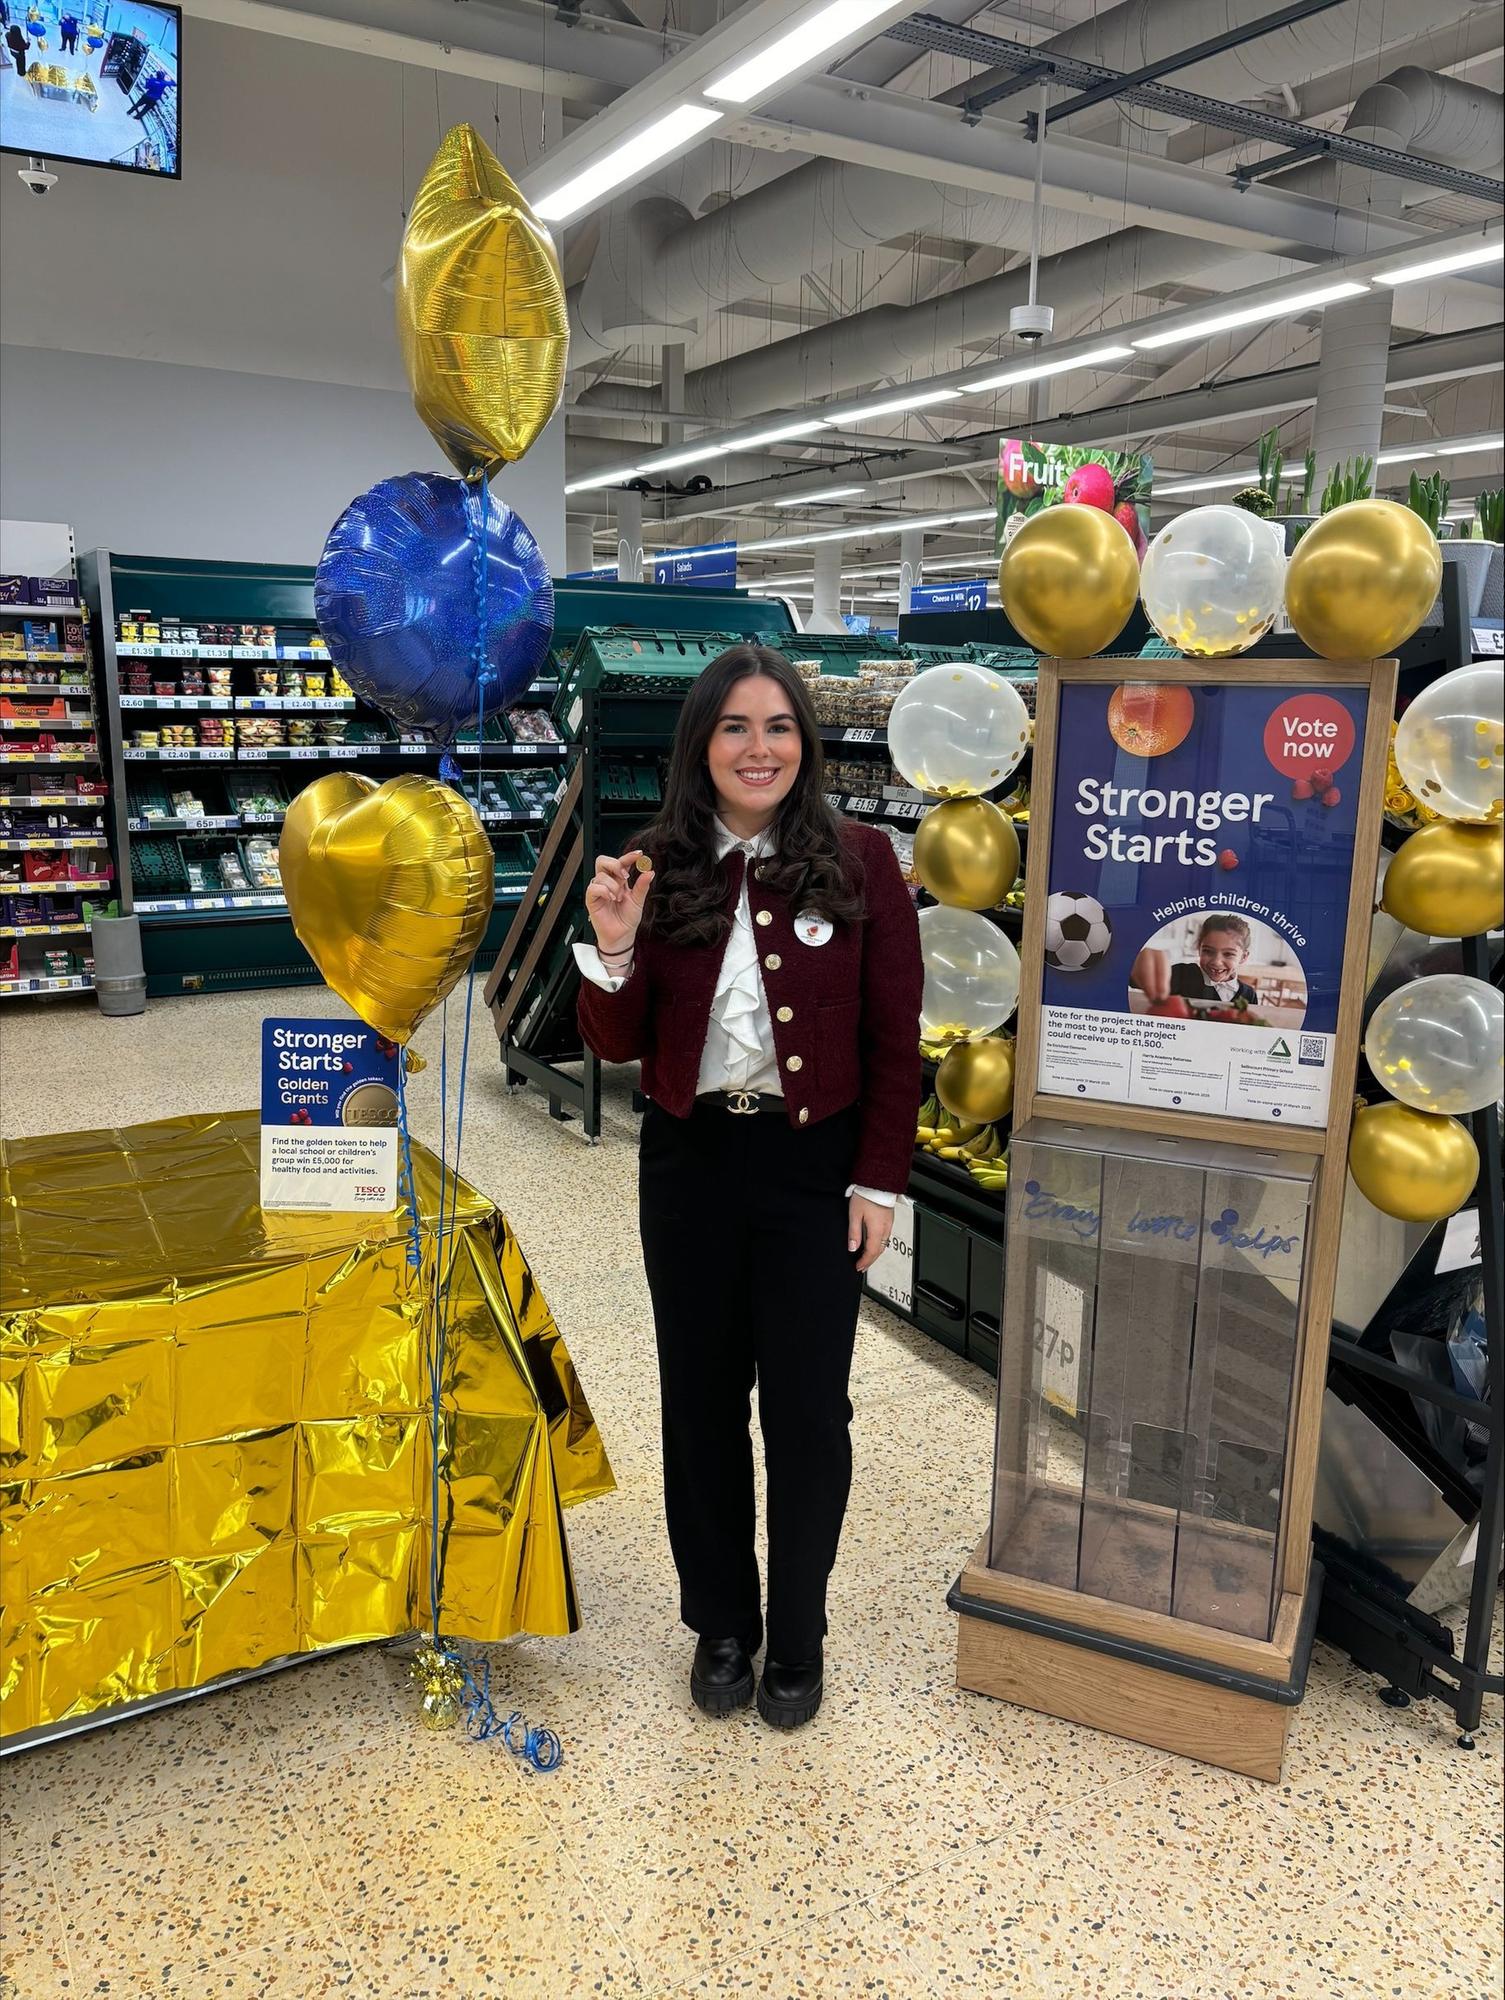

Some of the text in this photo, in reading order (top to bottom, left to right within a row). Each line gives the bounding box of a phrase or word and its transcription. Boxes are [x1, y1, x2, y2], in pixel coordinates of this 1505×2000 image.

[1009, 453, 1065, 486] Fruit
[676, 562, 692, 572] Salads
[968, 594, 980, 610] 12
[1283, 716, 1338, 737] Vote
[851, 729, 872, 741] £1.15
[1284, 742, 1334, 758] now
[854, 799, 876, 810] £1.15
[898, 803, 912, 816] £4
[1075, 778, 1274, 831] Stronger
[1083, 823, 1217, 866] Starts
[1152, 893, 1307, 947] Helping children thrive
[1048, 1010, 1186, 1031] Vote for the project that means
[273, 1028, 367, 1053] Stronger
[1048, 1030, 1164, 1049] could receive up to £1,500.
[1100, 1026, 1118, 1035] you.
[1120, 1028, 1141, 1036] Each
[1144, 1031, 1176, 1040] project
[1230, 1046, 1253, 1055] Working
[279, 1051, 343, 1071] Starts
[278, 1077, 328, 1090] Golden
[352, 1078, 368, 1087] golden
[281, 1091, 328, 1104] Grants
[347, 1108, 398, 1119] TESCO
[369, 1140, 387, 1148] help
[272, 1166, 300, 1174] healthy
[888, 1286, 912, 1306] £1.70
[1033, 1318, 1074, 1368] 27p
